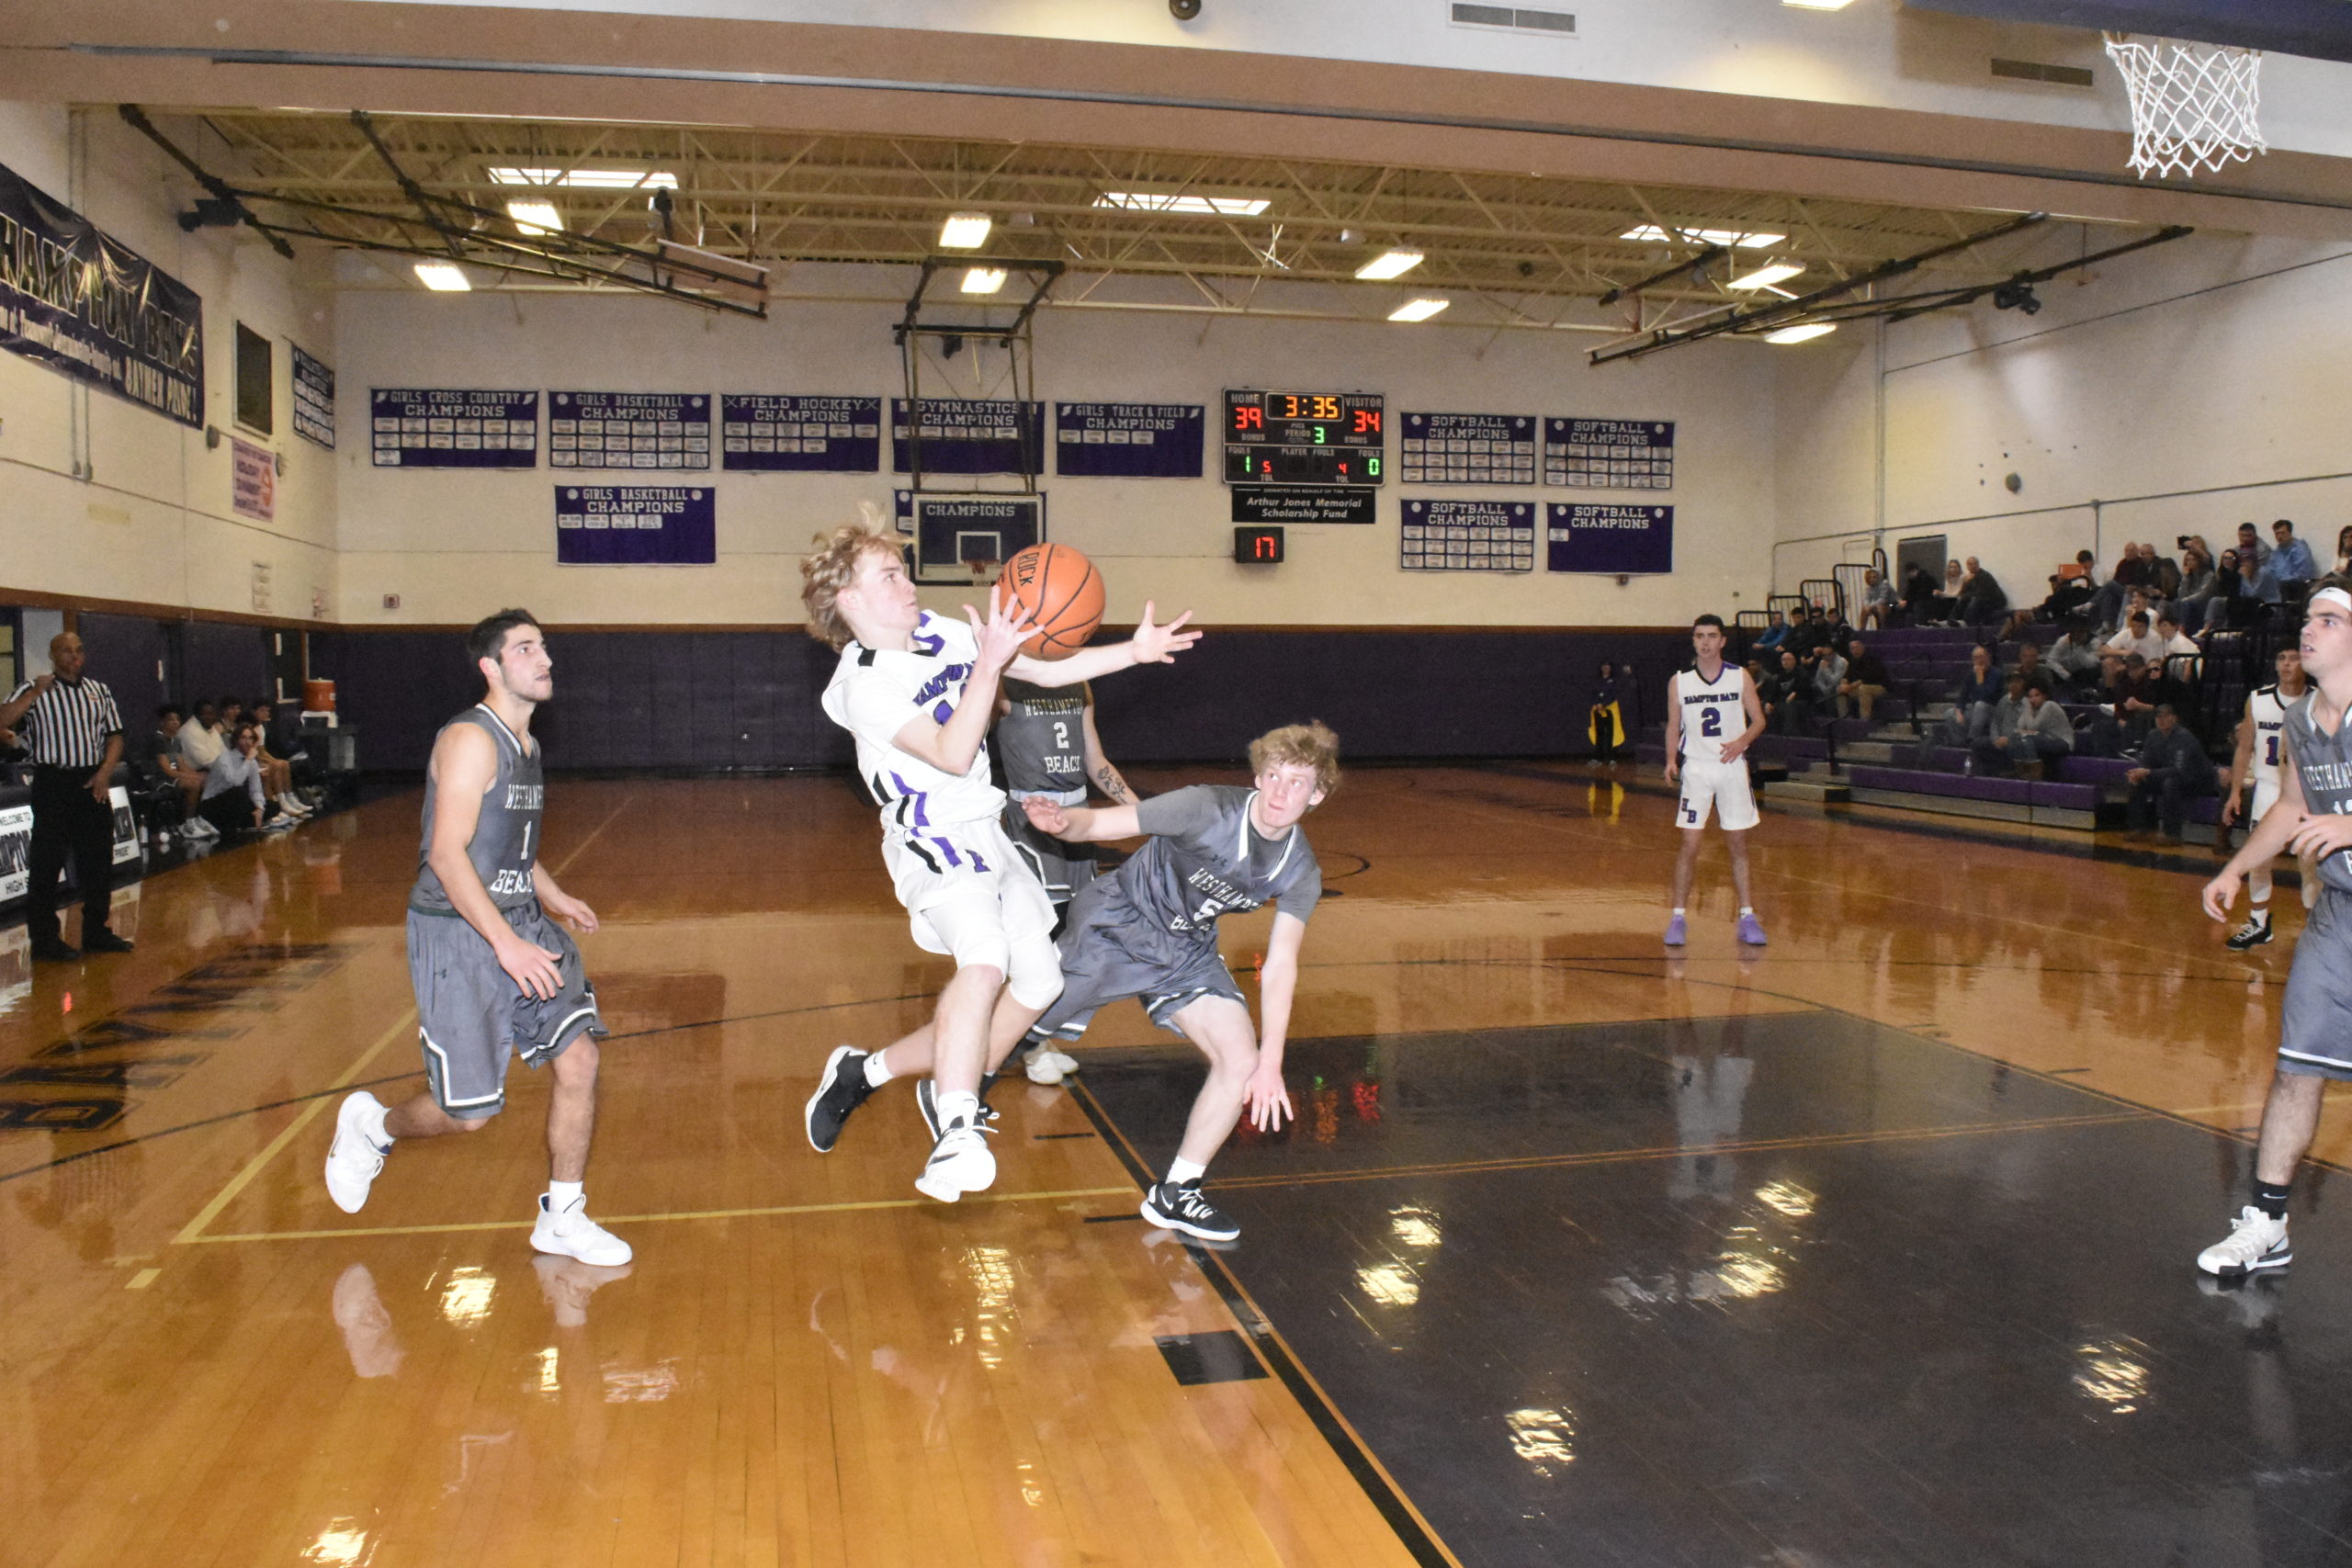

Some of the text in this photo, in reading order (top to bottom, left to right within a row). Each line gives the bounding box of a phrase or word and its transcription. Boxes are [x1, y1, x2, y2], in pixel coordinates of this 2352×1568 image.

[390, 391, 520, 404] GIRLS CROSS COUNTRY
[576, 394, 684, 407] GIRLS BASKETBALL
[740, 397, 864, 411] FIELD HOCKEY
[1231, 394, 1260, 404] HOME
[1345, 397, 1382, 408] VISITOR
[405, 404, 505, 417] CHAMPIONS
[582, 407, 679, 420] CHAMPIONS
[919, 401, 1019, 413] GYMNASTICS
[1076, 405, 1104, 416] GIRLS
[1113, 406, 1145, 417] TRACK
[1158, 407, 1185, 418] FIELD
[1285, 396, 1339, 419] 3:35
[754, 410, 850, 422] CHAMPIONS
[922, 414, 1014, 426] CHAMPIONS
[1235, 407, 1261, 429] 39
[1354, 411, 1380, 432] 34
[1430, 416, 1506, 428] SOFTBALL
[1087, 418, 1175, 430] CHAMPIONS
[1574, 422, 1645, 434] SOFTBALL
[1314, 426, 1325, 444] 3
[1428, 428, 1510, 439] CHAMPIONS
[1571, 433, 1648, 446] CHAMPIONS
[1262, 460, 1272, 473] 5
[1369, 457, 1380, 476] 0
[582, 488, 688, 501] GIRLS BASKETBALL
[587, 502, 684, 513] CHAMPIONS
[1247, 497, 1362, 507] Arthur Jones Memorial
[1430, 502, 1506, 514] SOFTBALL
[926, 505, 1015, 517] CHAMPIONS
[1261, 508, 1348, 519] Scholarship Fund
[1575, 506, 1646, 518] SOFTBALL
[1428, 514, 1509, 525] CHAMPIONS
[1571, 517, 1649, 529] CHAMPIONS
[1255, 536, 1275, 558] 17
[1017, 552, 1039, 587] ROCK
[1702, 707, 1722, 737] 2
[1053, 721, 1069, 749] 2
[520, 820, 532, 860] 1
[1193, 898, 1224, 921] 5
